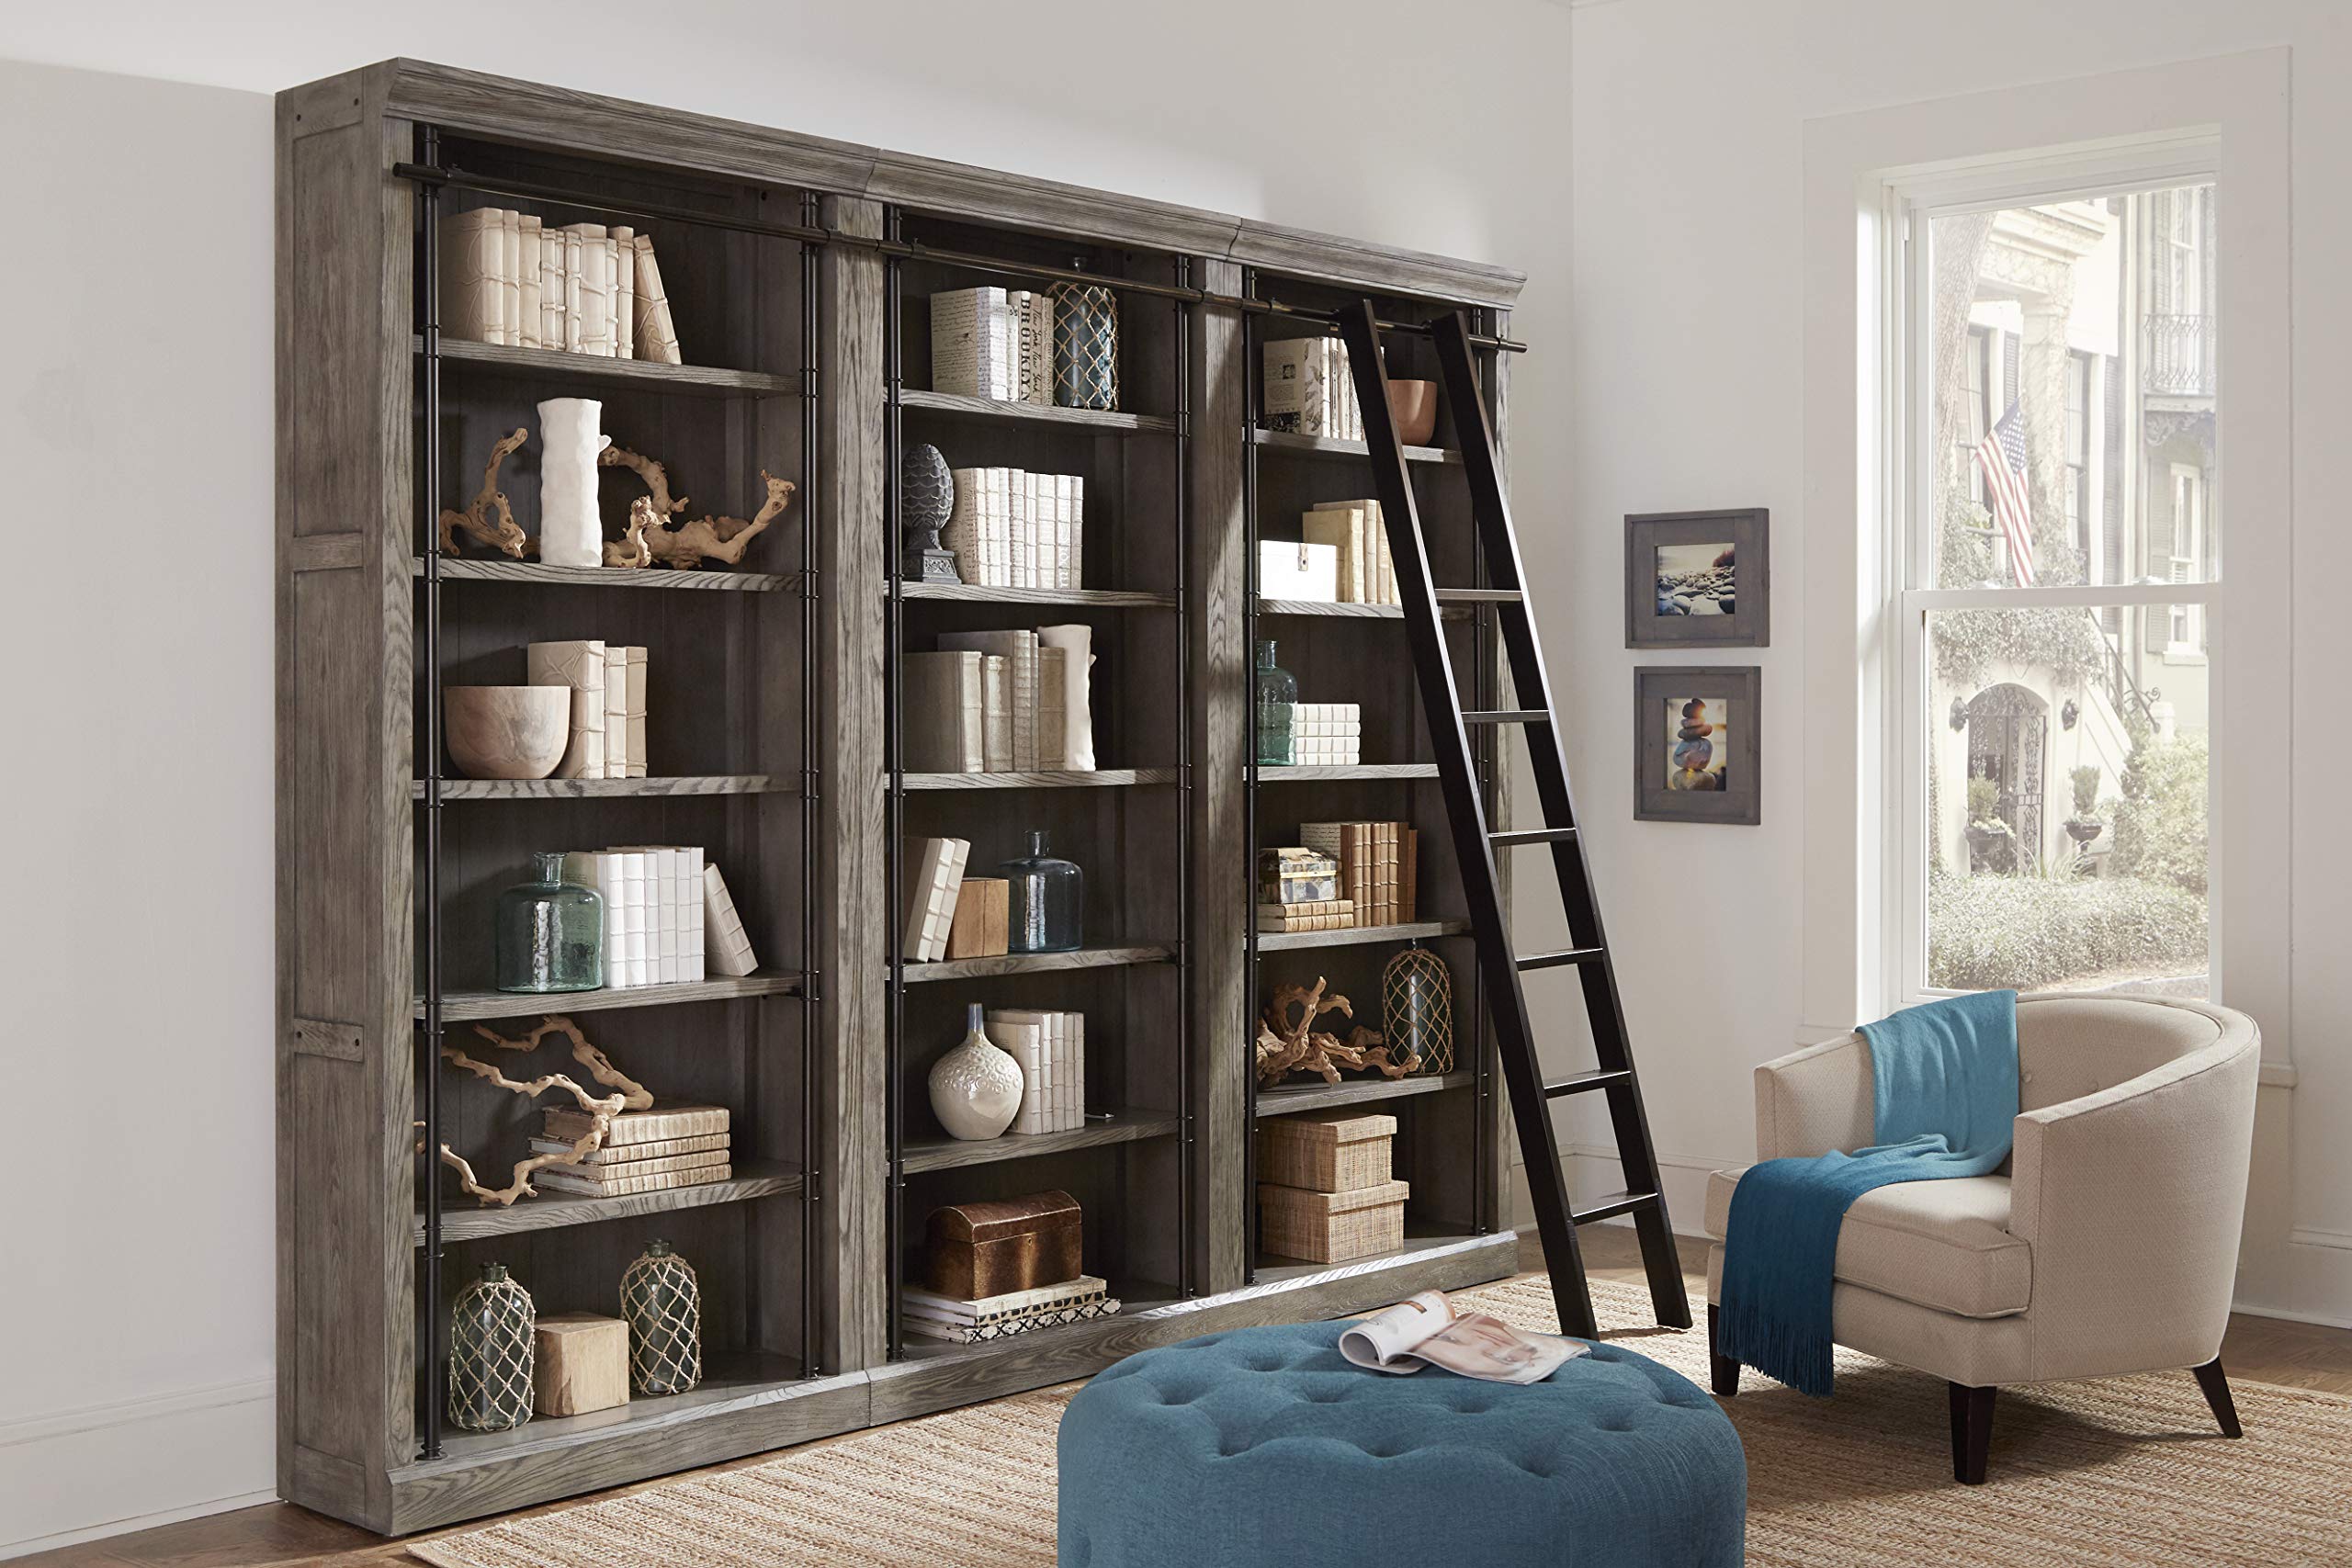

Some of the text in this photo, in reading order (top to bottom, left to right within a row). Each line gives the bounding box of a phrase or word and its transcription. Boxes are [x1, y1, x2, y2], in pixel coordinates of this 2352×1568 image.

[1033, 309, 1042, 326] New
[1021, 299, 1030, 402] BROOKLYN
[1033, 351, 1042, 369] New
